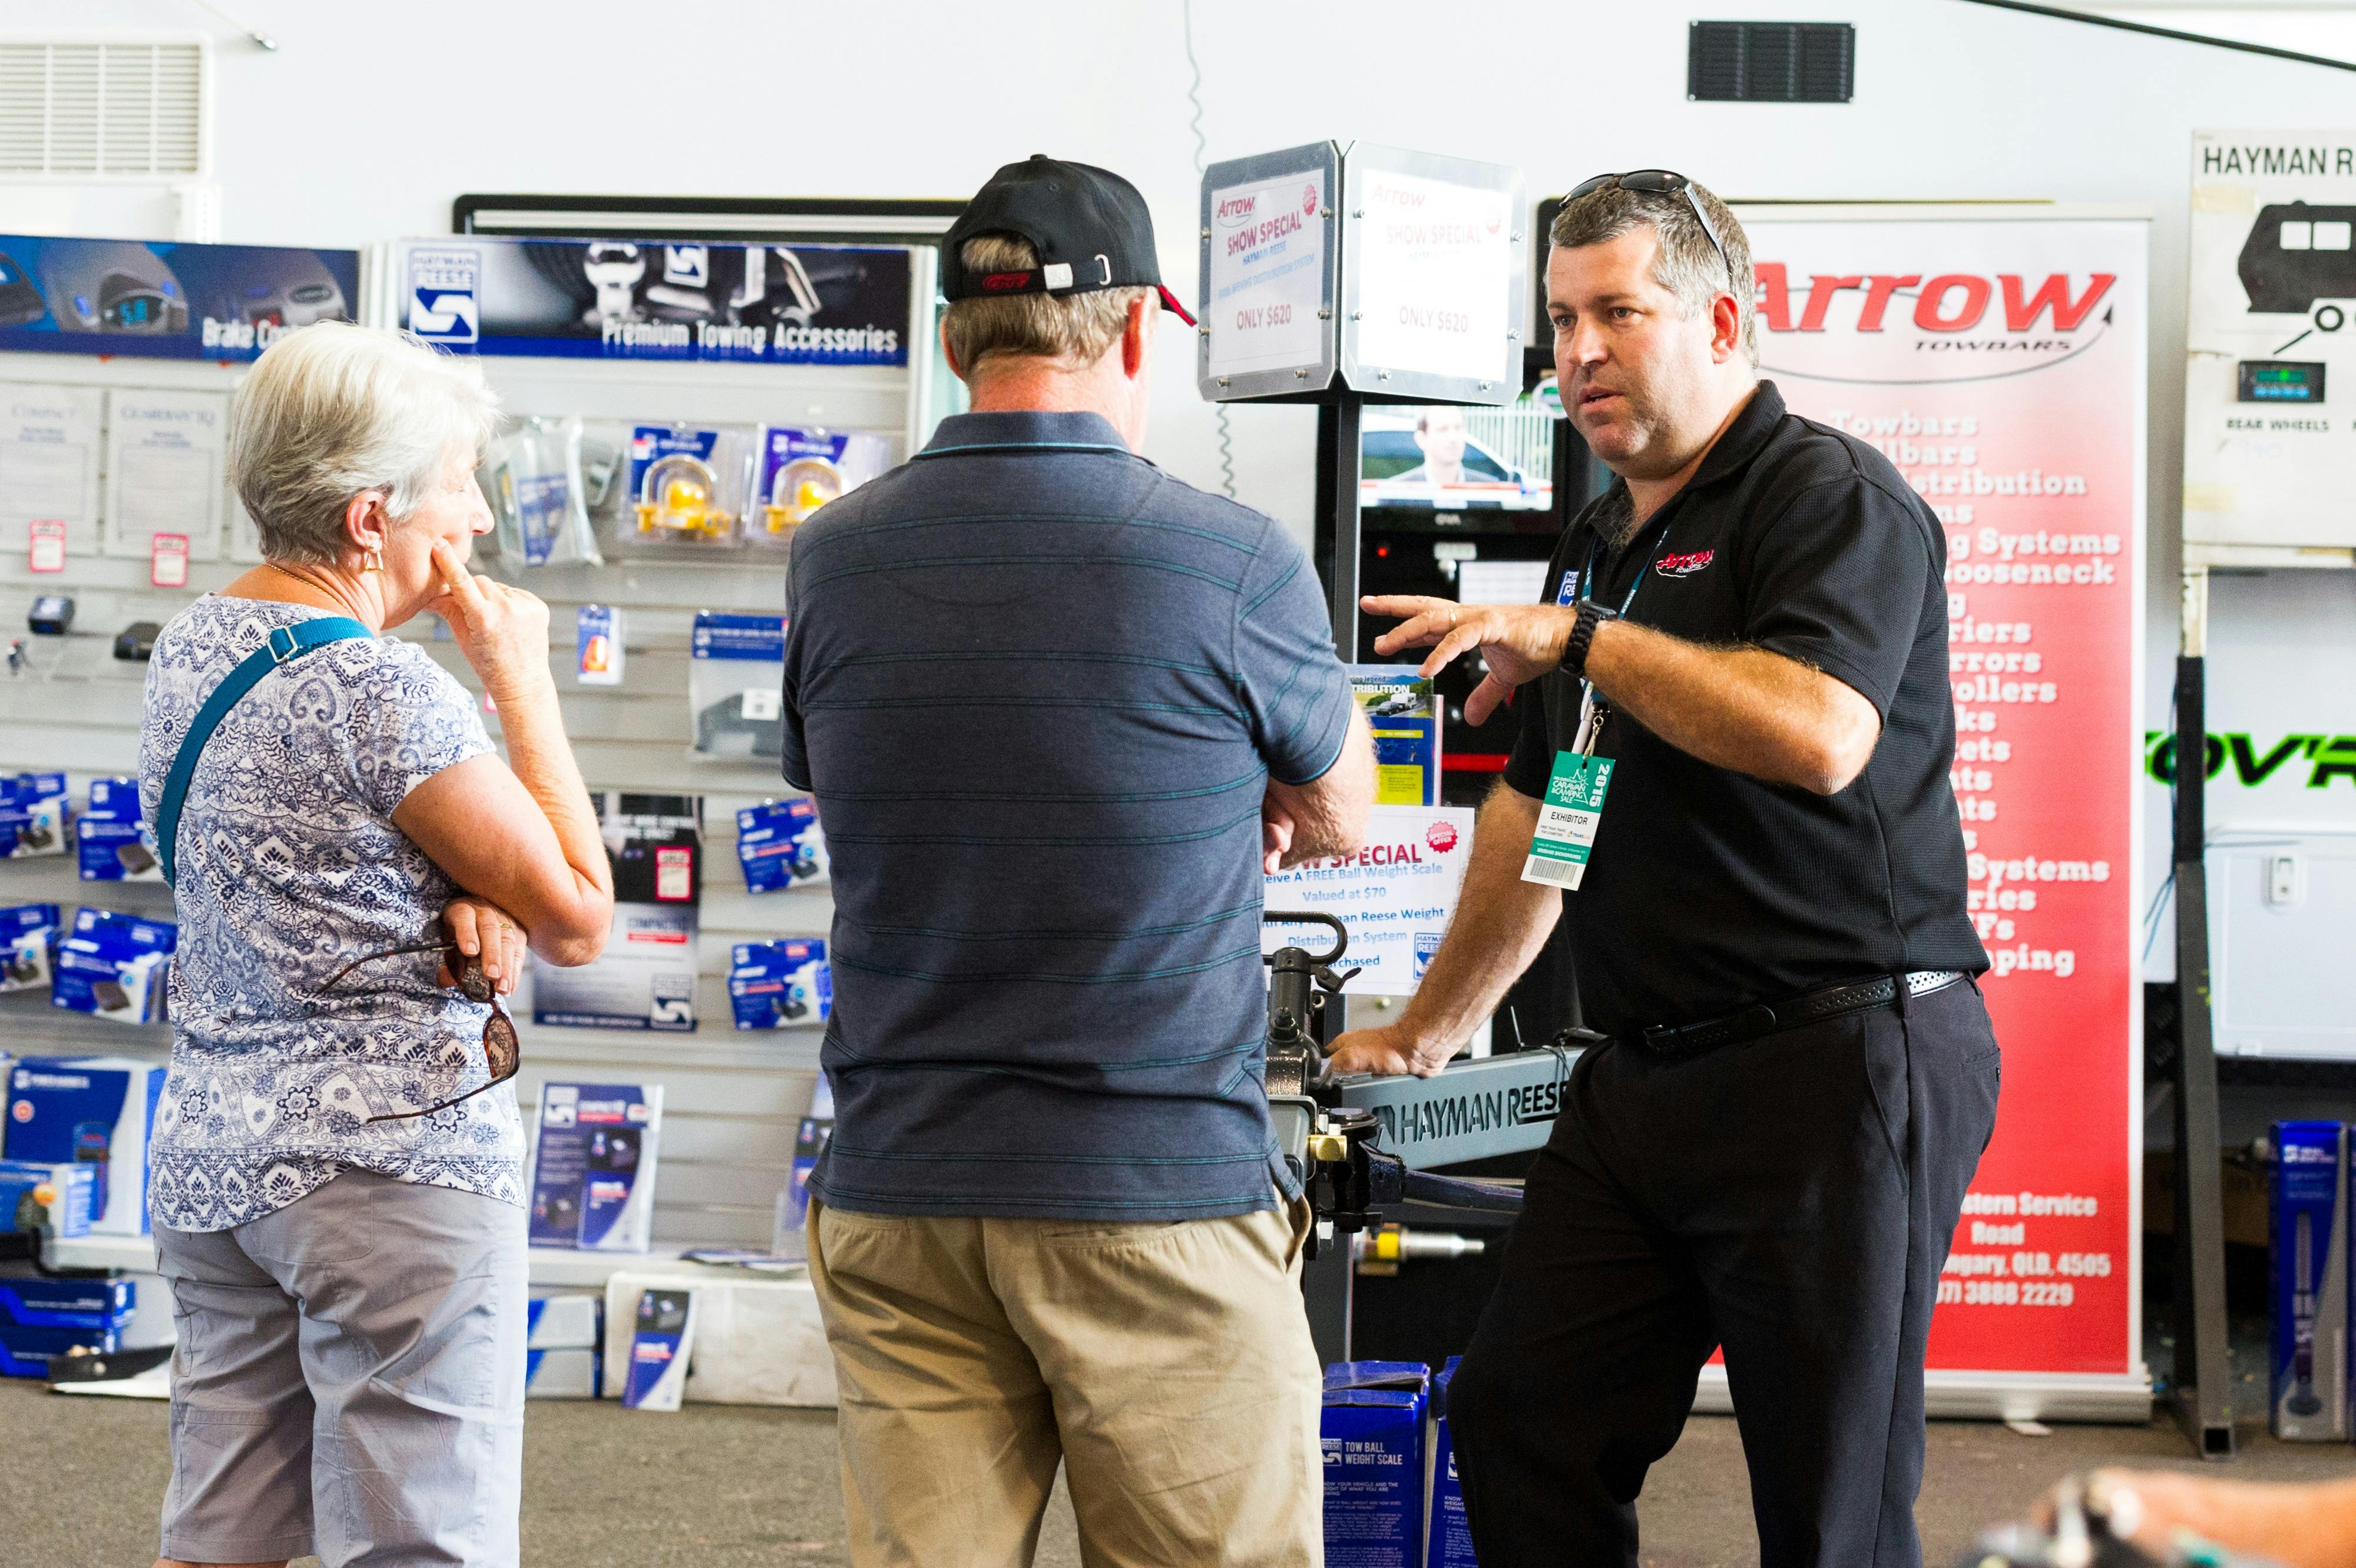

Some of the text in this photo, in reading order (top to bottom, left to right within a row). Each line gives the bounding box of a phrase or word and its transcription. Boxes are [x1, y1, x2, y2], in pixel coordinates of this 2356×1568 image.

[2204, 147, 2356, 174] HAYMAN R
[1217, 196, 1255, 218] Arrow
[1227, 210, 1302, 256] SHOW SPECIAL
[1387, 225, 1483, 245] SHOW SPECIAL
[1753, 262, 2117, 333] Arrow
[1237, 303, 1292, 330] ONLY $620
[1399, 306, 1468, 333] ONLY $620
[202, 316, 255, 349] Brake
[601, 318, 898, 354] Premium Towing Accessories
[1915, 339, 2070, 350] TOWBARS
[1833, 412, 1978, 436] Towbars
[2226, 419, 2329, 431] REAR WHEELS
[1948, 528, 2122, 561] g Systems
[1947, 593, 1967, 620] g
[1948, 615, 2032, 644] riers
[1948, 652, 2042, 673] rrors
[1950, 674, 2058, 703] ollers
[1953, 703, 1997, 732] ks
[1954, 736, 2011, 762] ets
[1553, 780, 1586, 792] CARAVAN
[1589, 763, 1610, 808] 2015
[1560, 795, 1574, 804] SALE
[1550, 811, 1588, 825] EXHIBITOR
[1429, 831, 1452, 841] SPECIAL
[1432, 836, 1452, 846] OFFER
[1964, 829, 1978, 852] s
[1265, 862, 1443, 884] eive A FREE Ball Weight Scale
[1967, 852, 2110, 888] Systems
[1302, 886, 1387, 902] Valued at $70
[1967, 886, 2037, 911] ries
[1362, 911, 1397, 921] Reese
[1401, 907, 1445, 921] Weight
[1288, 931, 1408, 947] Distribuon System
[1967, 913, 2016, 941] Fs
[1990, 942, 2076, 978] ping
[1400, 1090, 1502, 1144] HAYMAN
[2019, 1191, 2098, 1217] Service
[1971, 1220, 2026, 1245] Road
[1942, 1253, 2011, 1278] ngary,
[2056, 1252, 2112, 1278] 4505
[2021, 1282, 2074, 1307] 2229
[1345, 1441, 1385, 1453] TOW BALL
[1345, 1454, 1403, 1466] WEIGHT SCALE
